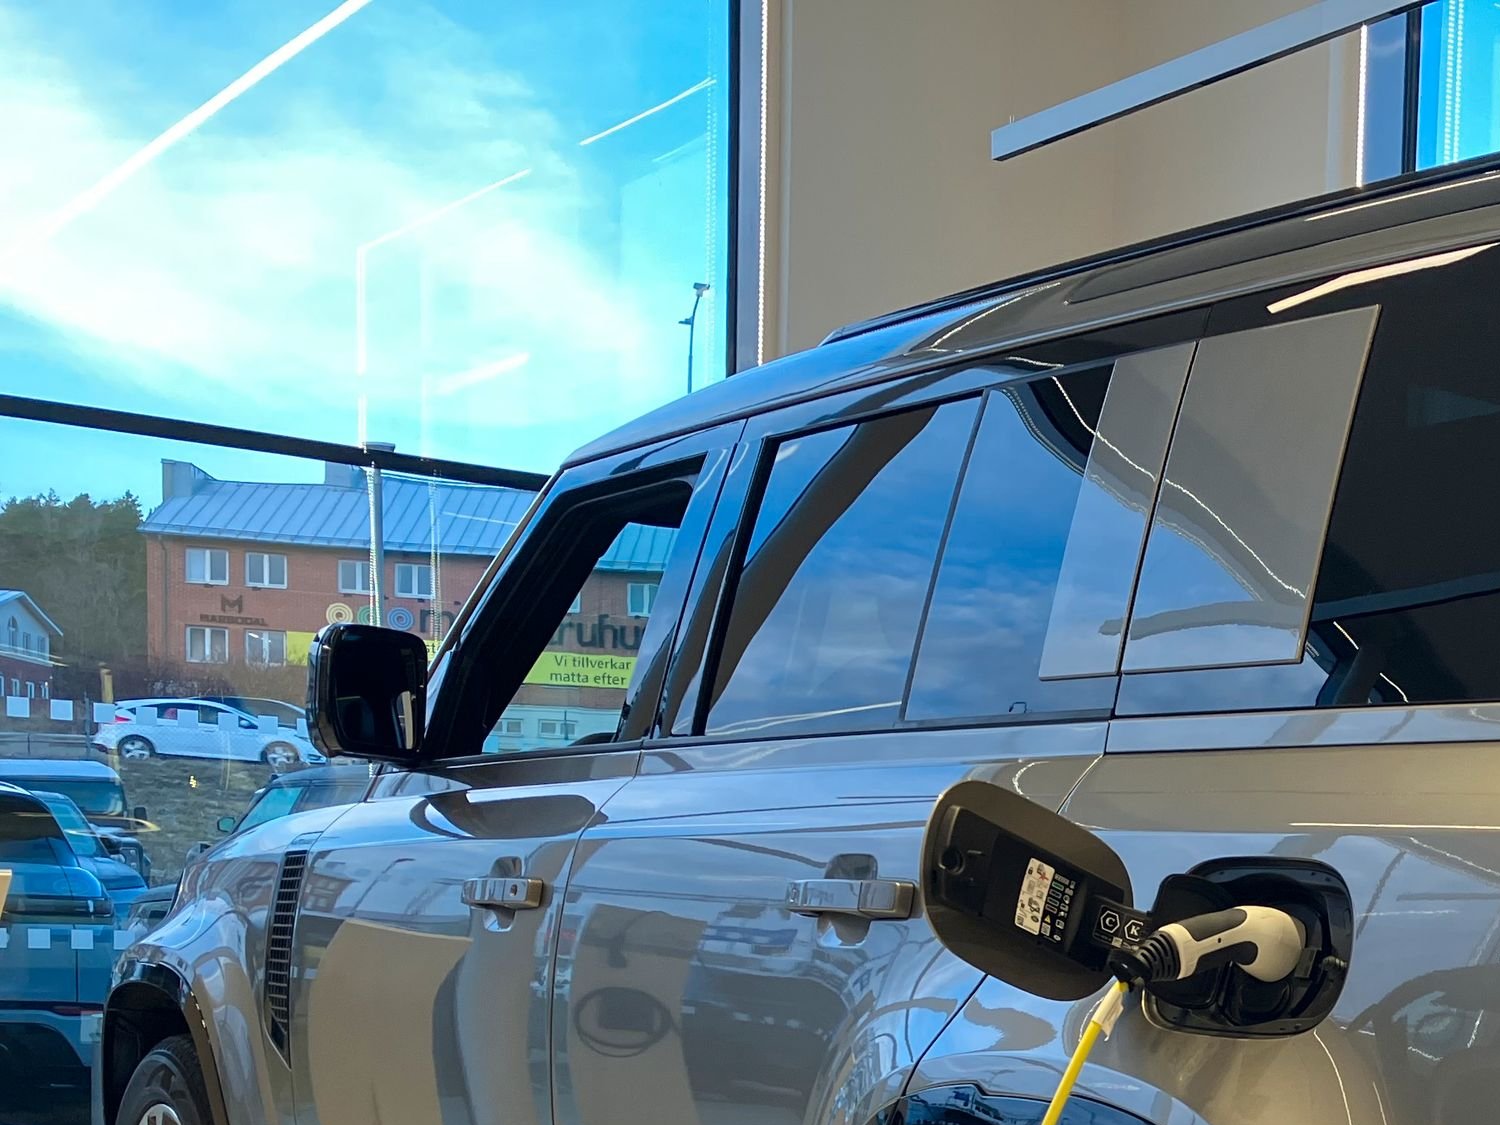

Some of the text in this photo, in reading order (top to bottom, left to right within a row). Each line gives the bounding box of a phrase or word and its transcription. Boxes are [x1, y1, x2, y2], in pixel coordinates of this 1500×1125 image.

[554, 656, 631, 670] Vi tillverkar
[550, 672, 626, 685] matta efter
